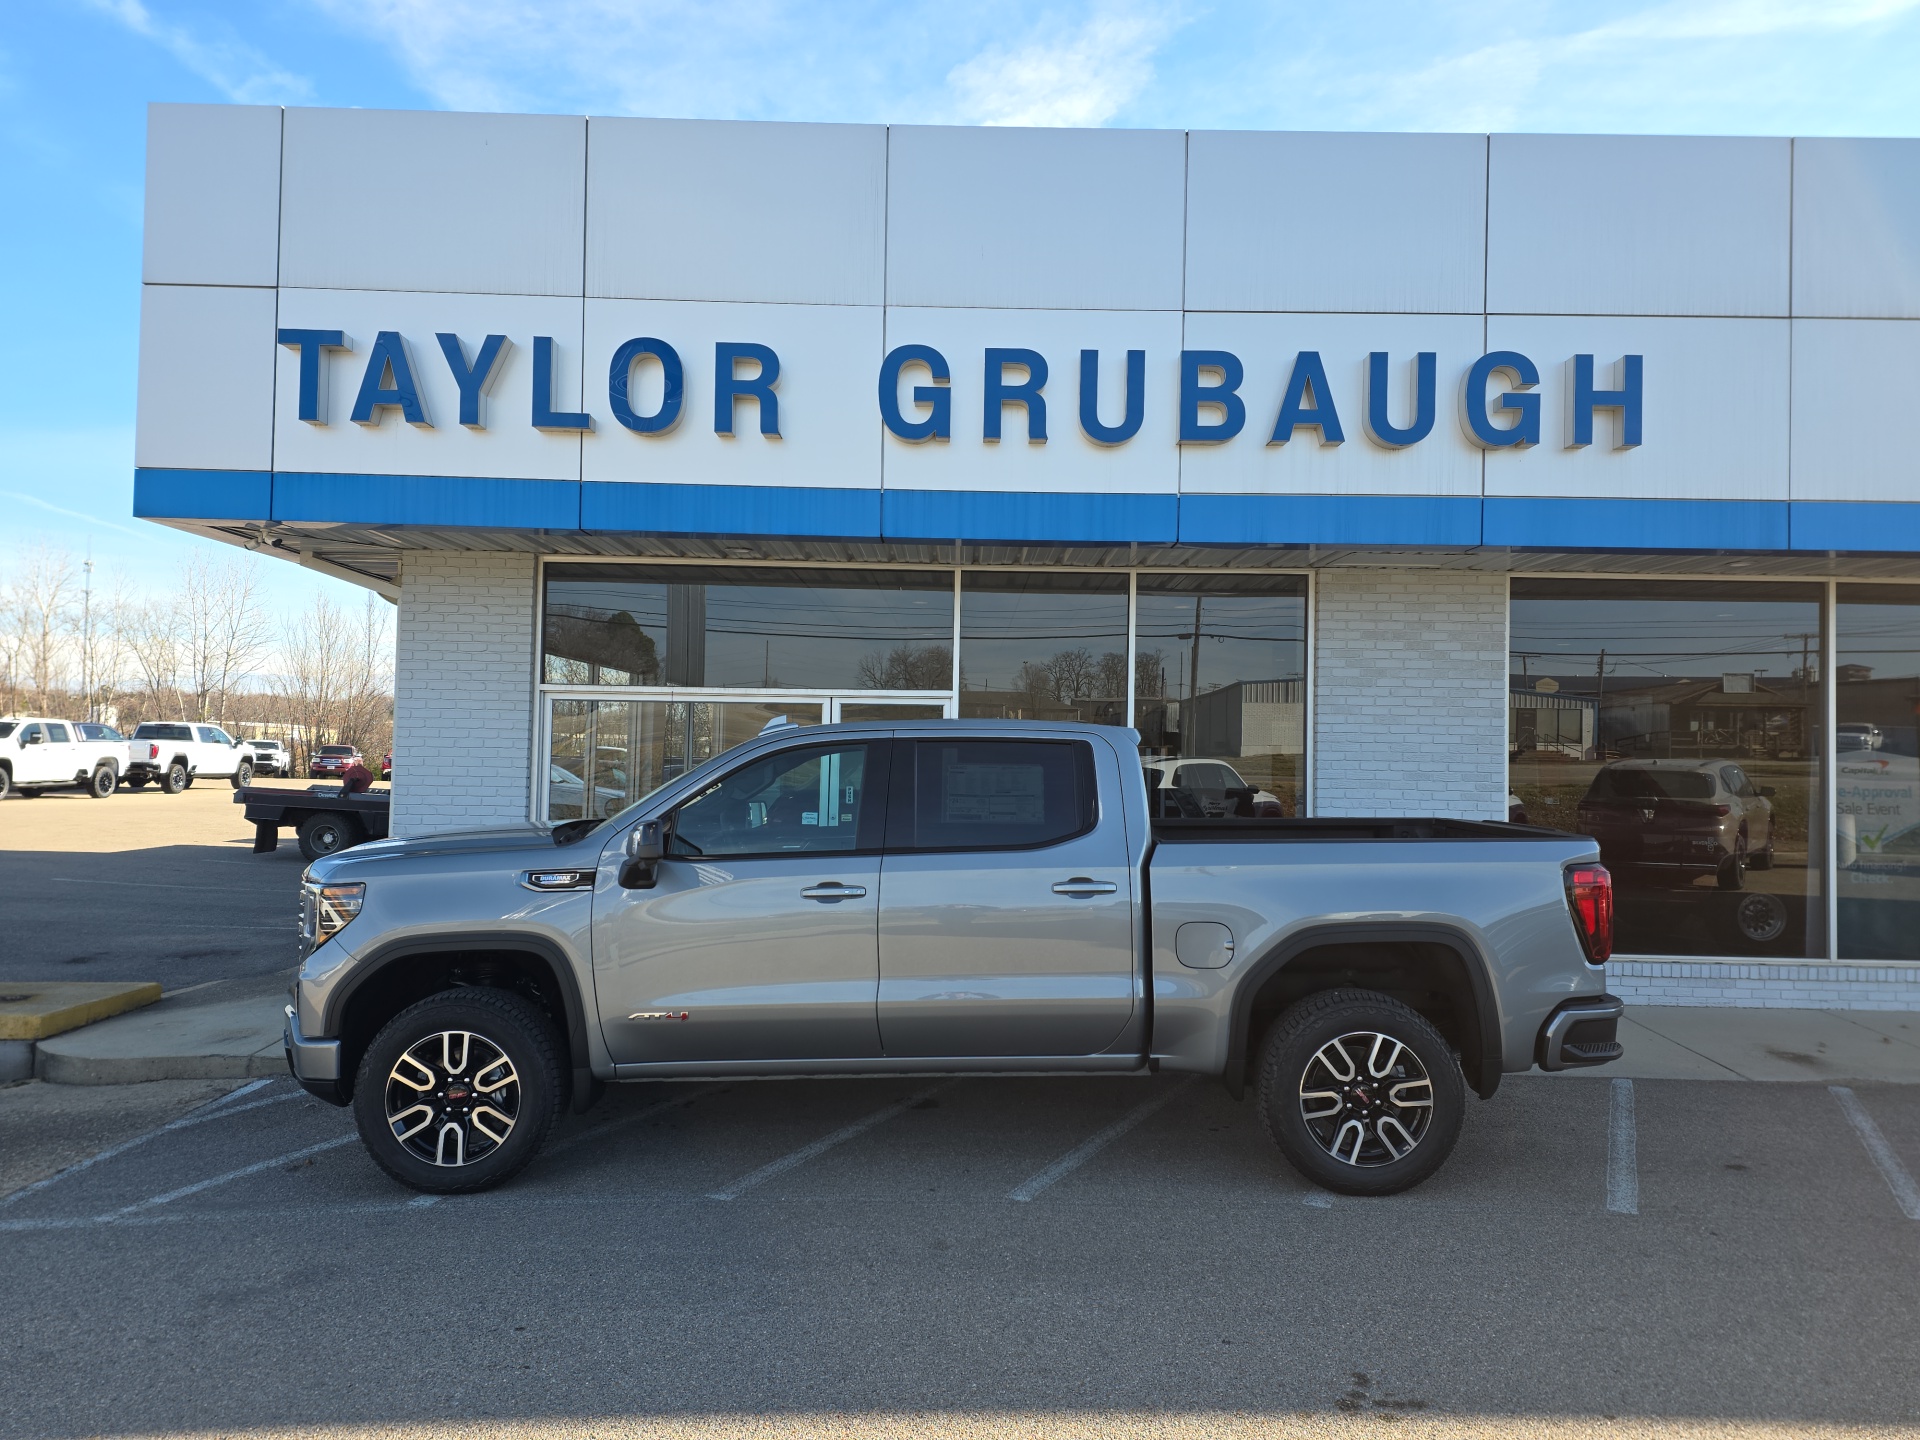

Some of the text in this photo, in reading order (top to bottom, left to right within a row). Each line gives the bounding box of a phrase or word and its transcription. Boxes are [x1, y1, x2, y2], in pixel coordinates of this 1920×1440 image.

[278, 328, 1643, 451] TAYLOR GRUBAUGH
[1838, 785, 1912, 800] e-Approval
[1836, 802, 1902, 816] Sale Event
[628, 1011, 689, 1020] AT4
[448, 1091, 467, 1100] GMC
